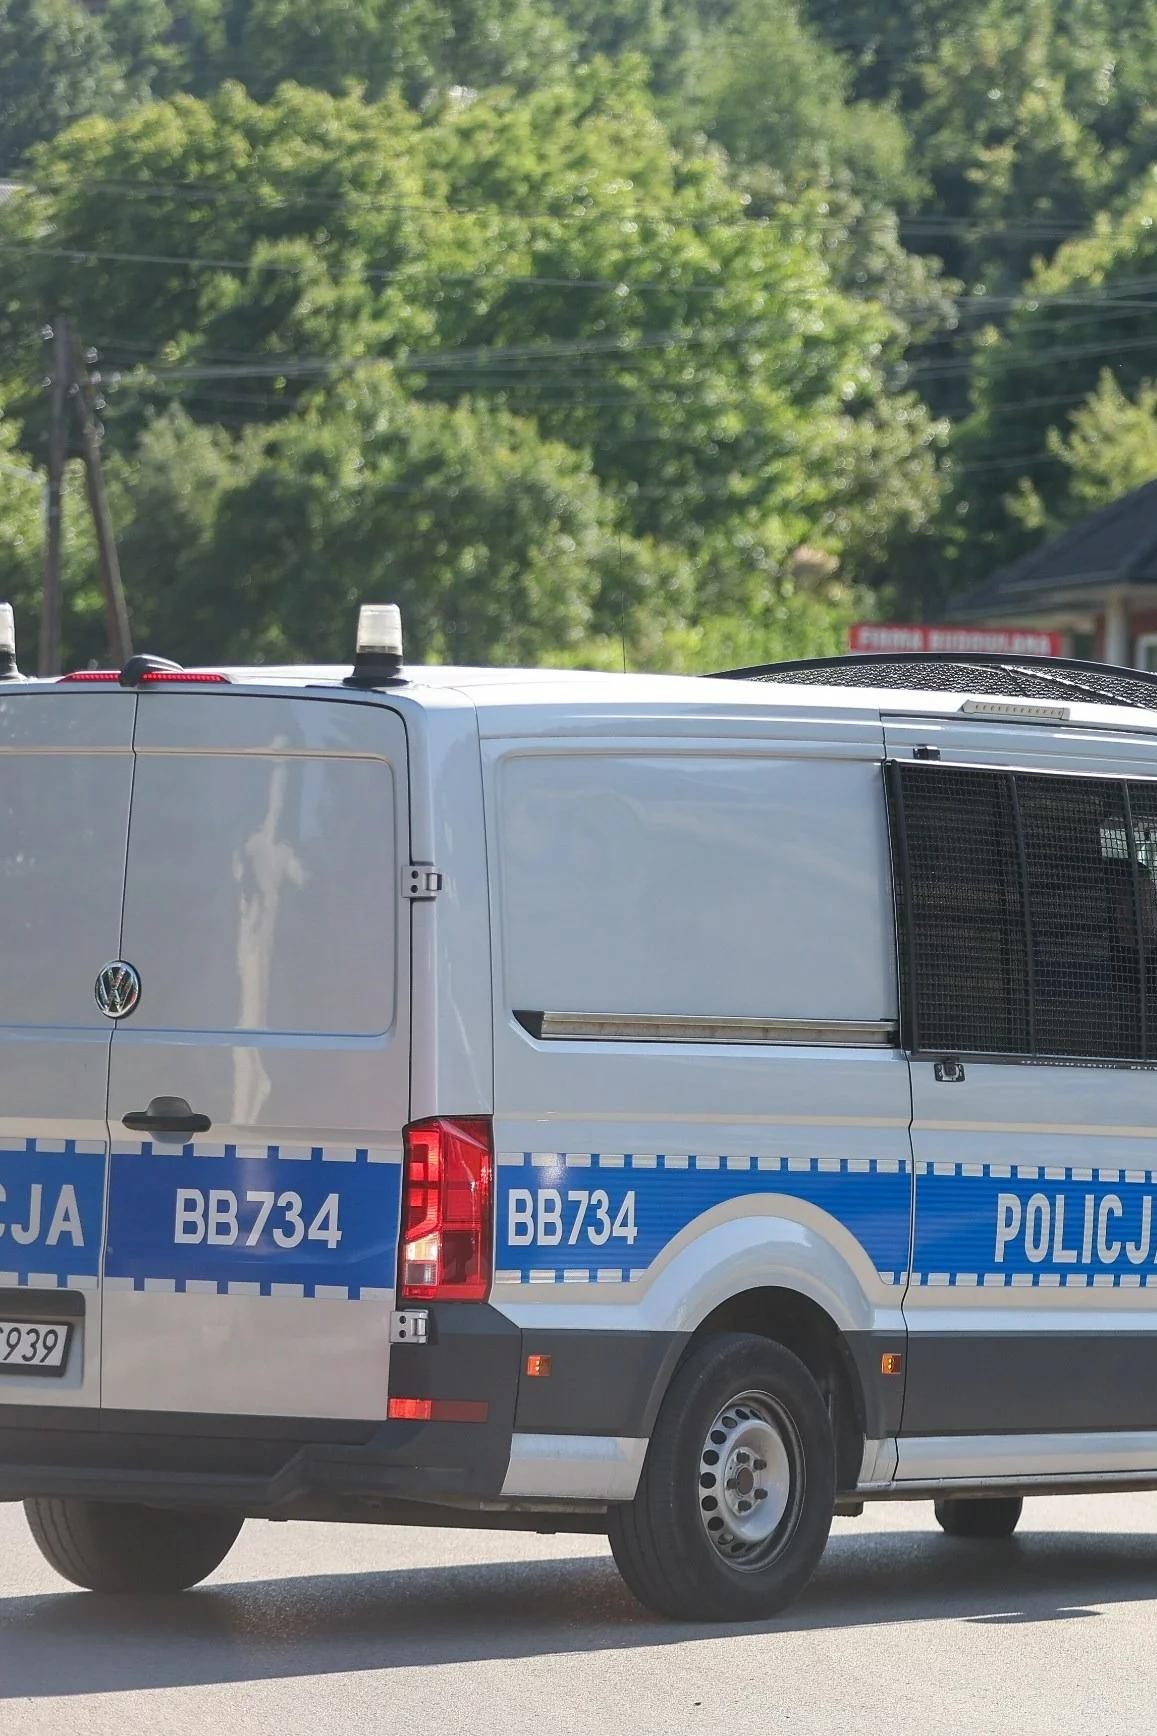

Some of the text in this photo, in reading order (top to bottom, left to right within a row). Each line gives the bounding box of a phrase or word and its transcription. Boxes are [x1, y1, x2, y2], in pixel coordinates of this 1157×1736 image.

[0, 1183, 85, 1247] JA
[174, 1188, 343, 1249] BB734
[508, 1188, 638, 1246] BB734
[0, 1326, 59, 1364] 939
